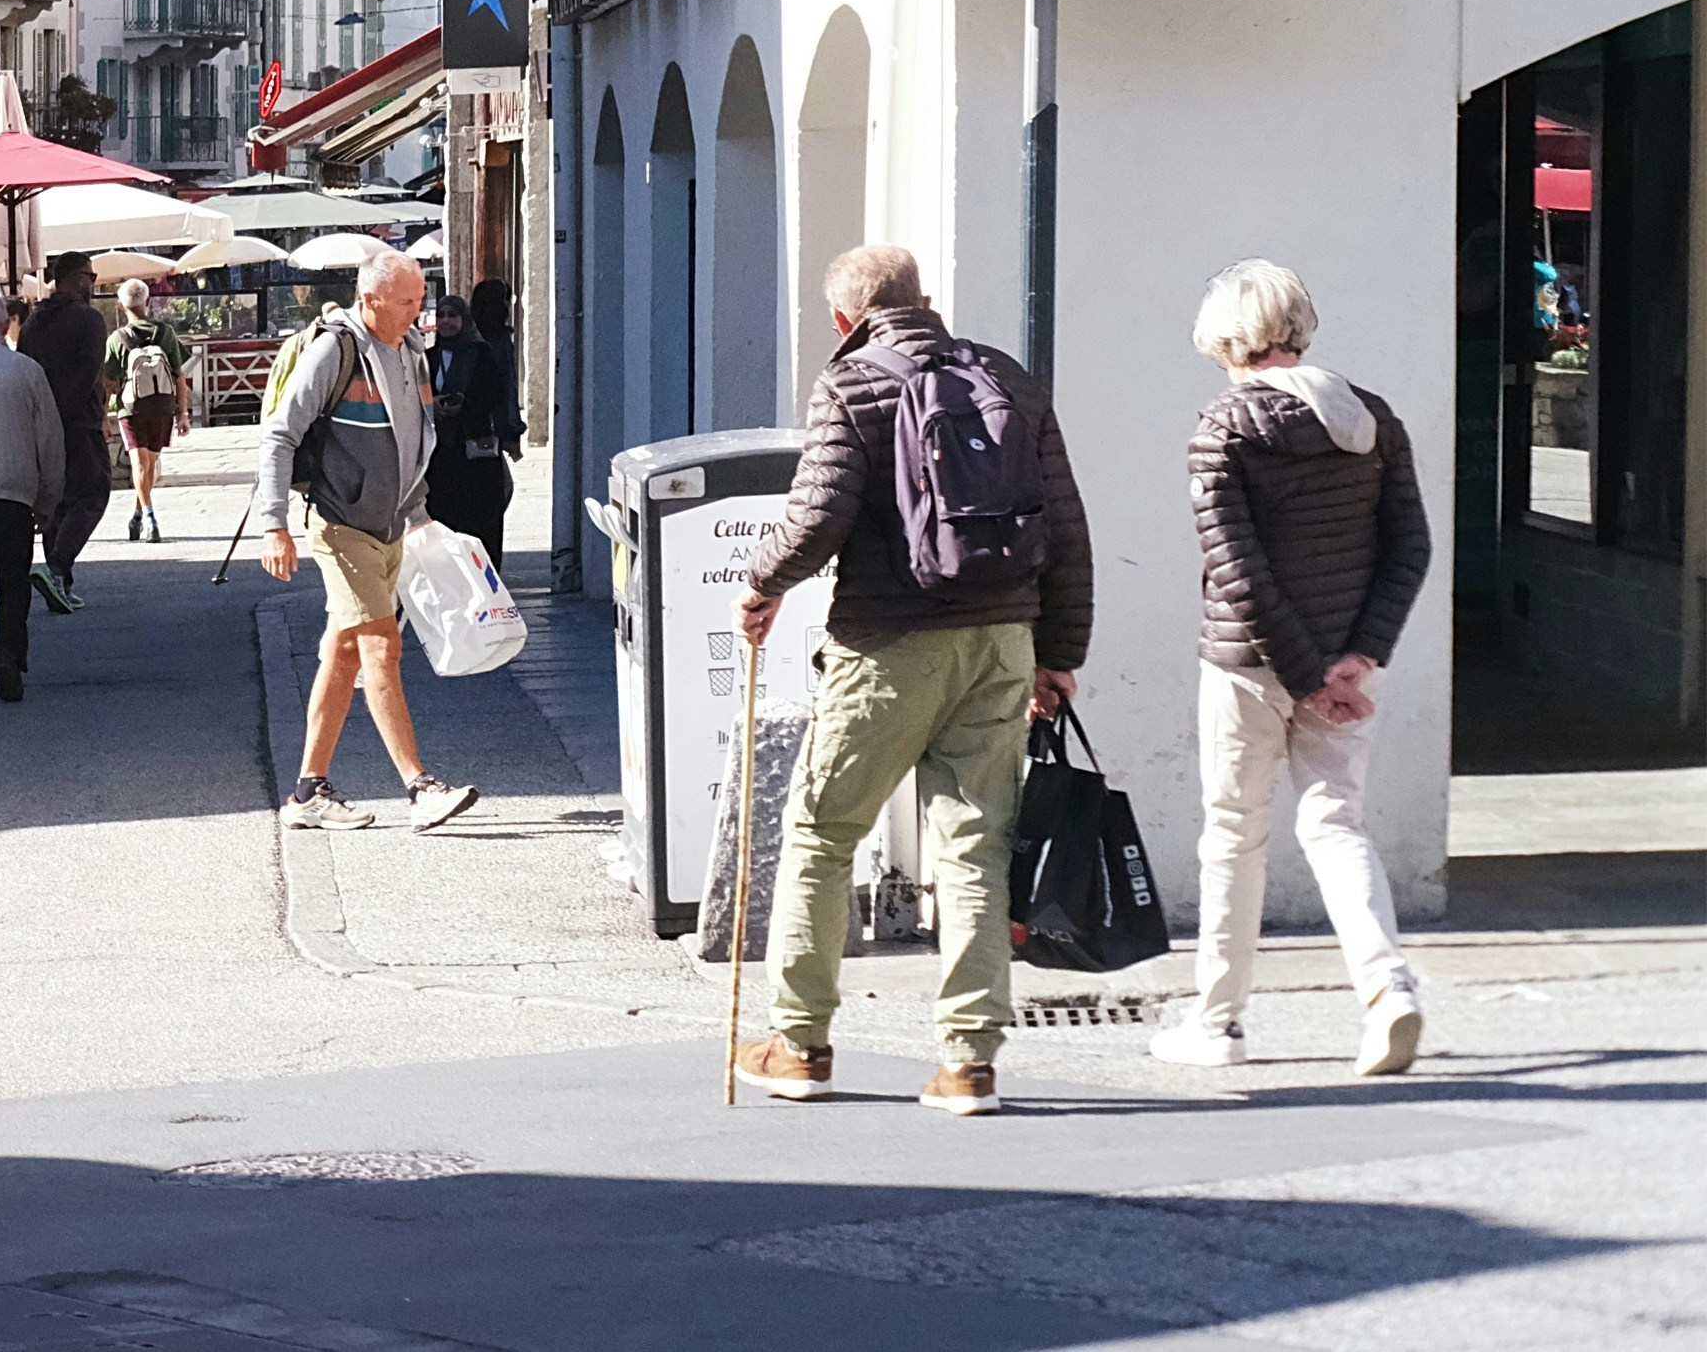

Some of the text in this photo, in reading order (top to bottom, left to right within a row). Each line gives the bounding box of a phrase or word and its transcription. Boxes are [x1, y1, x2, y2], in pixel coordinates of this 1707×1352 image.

[264, 71, 277, 108] TABAC
[714, 519, 756, 539] Cette
[702, 565, 748, 585] votre
